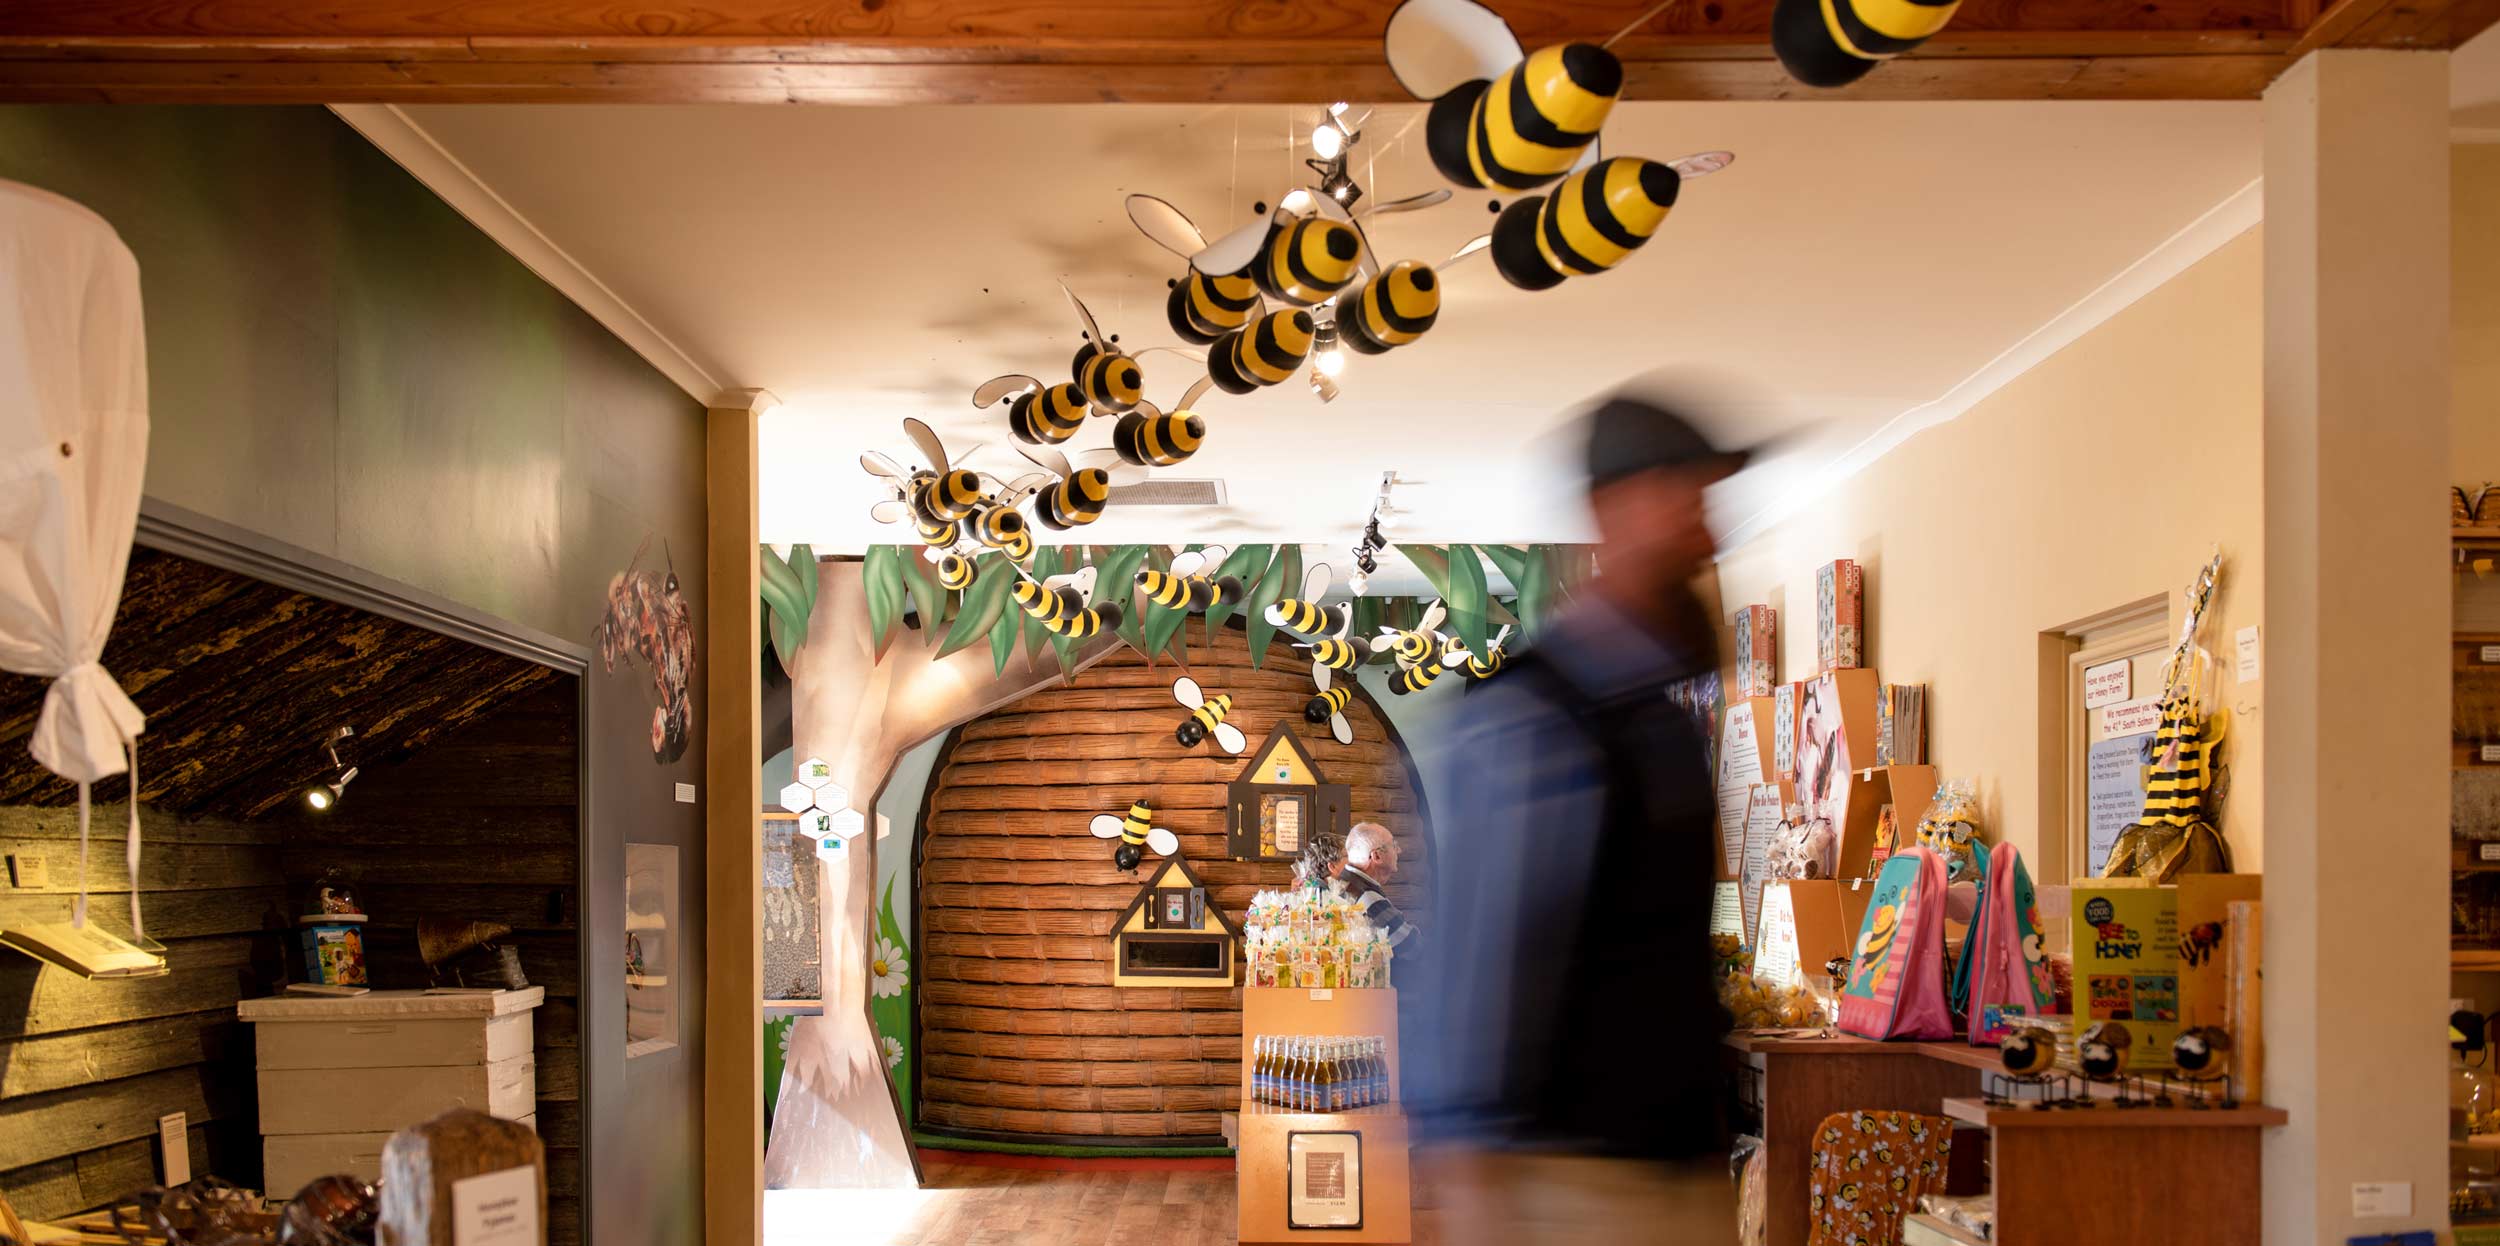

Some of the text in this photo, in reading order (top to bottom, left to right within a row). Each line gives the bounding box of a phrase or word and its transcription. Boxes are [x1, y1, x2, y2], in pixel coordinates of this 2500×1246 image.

[2087, 667, 2125, 686] Have you enjoyed
[2095, 688, 2108, 698] Honey
[2109, 682, 2124, 695] Farm?
[2106, 710, 2115, 719] We
[2115, 704, 2141, 717] recommend
[2141, 703, 2151, 713] you
[2103, 724, 2111, 733] the
[2122, 719, 2136, 730] South
[2137, 716, 2154, 727] Salmon
[2098, 923, 2141, 941] BEE TO
[2095, 941, 2142, 959] HONEY
